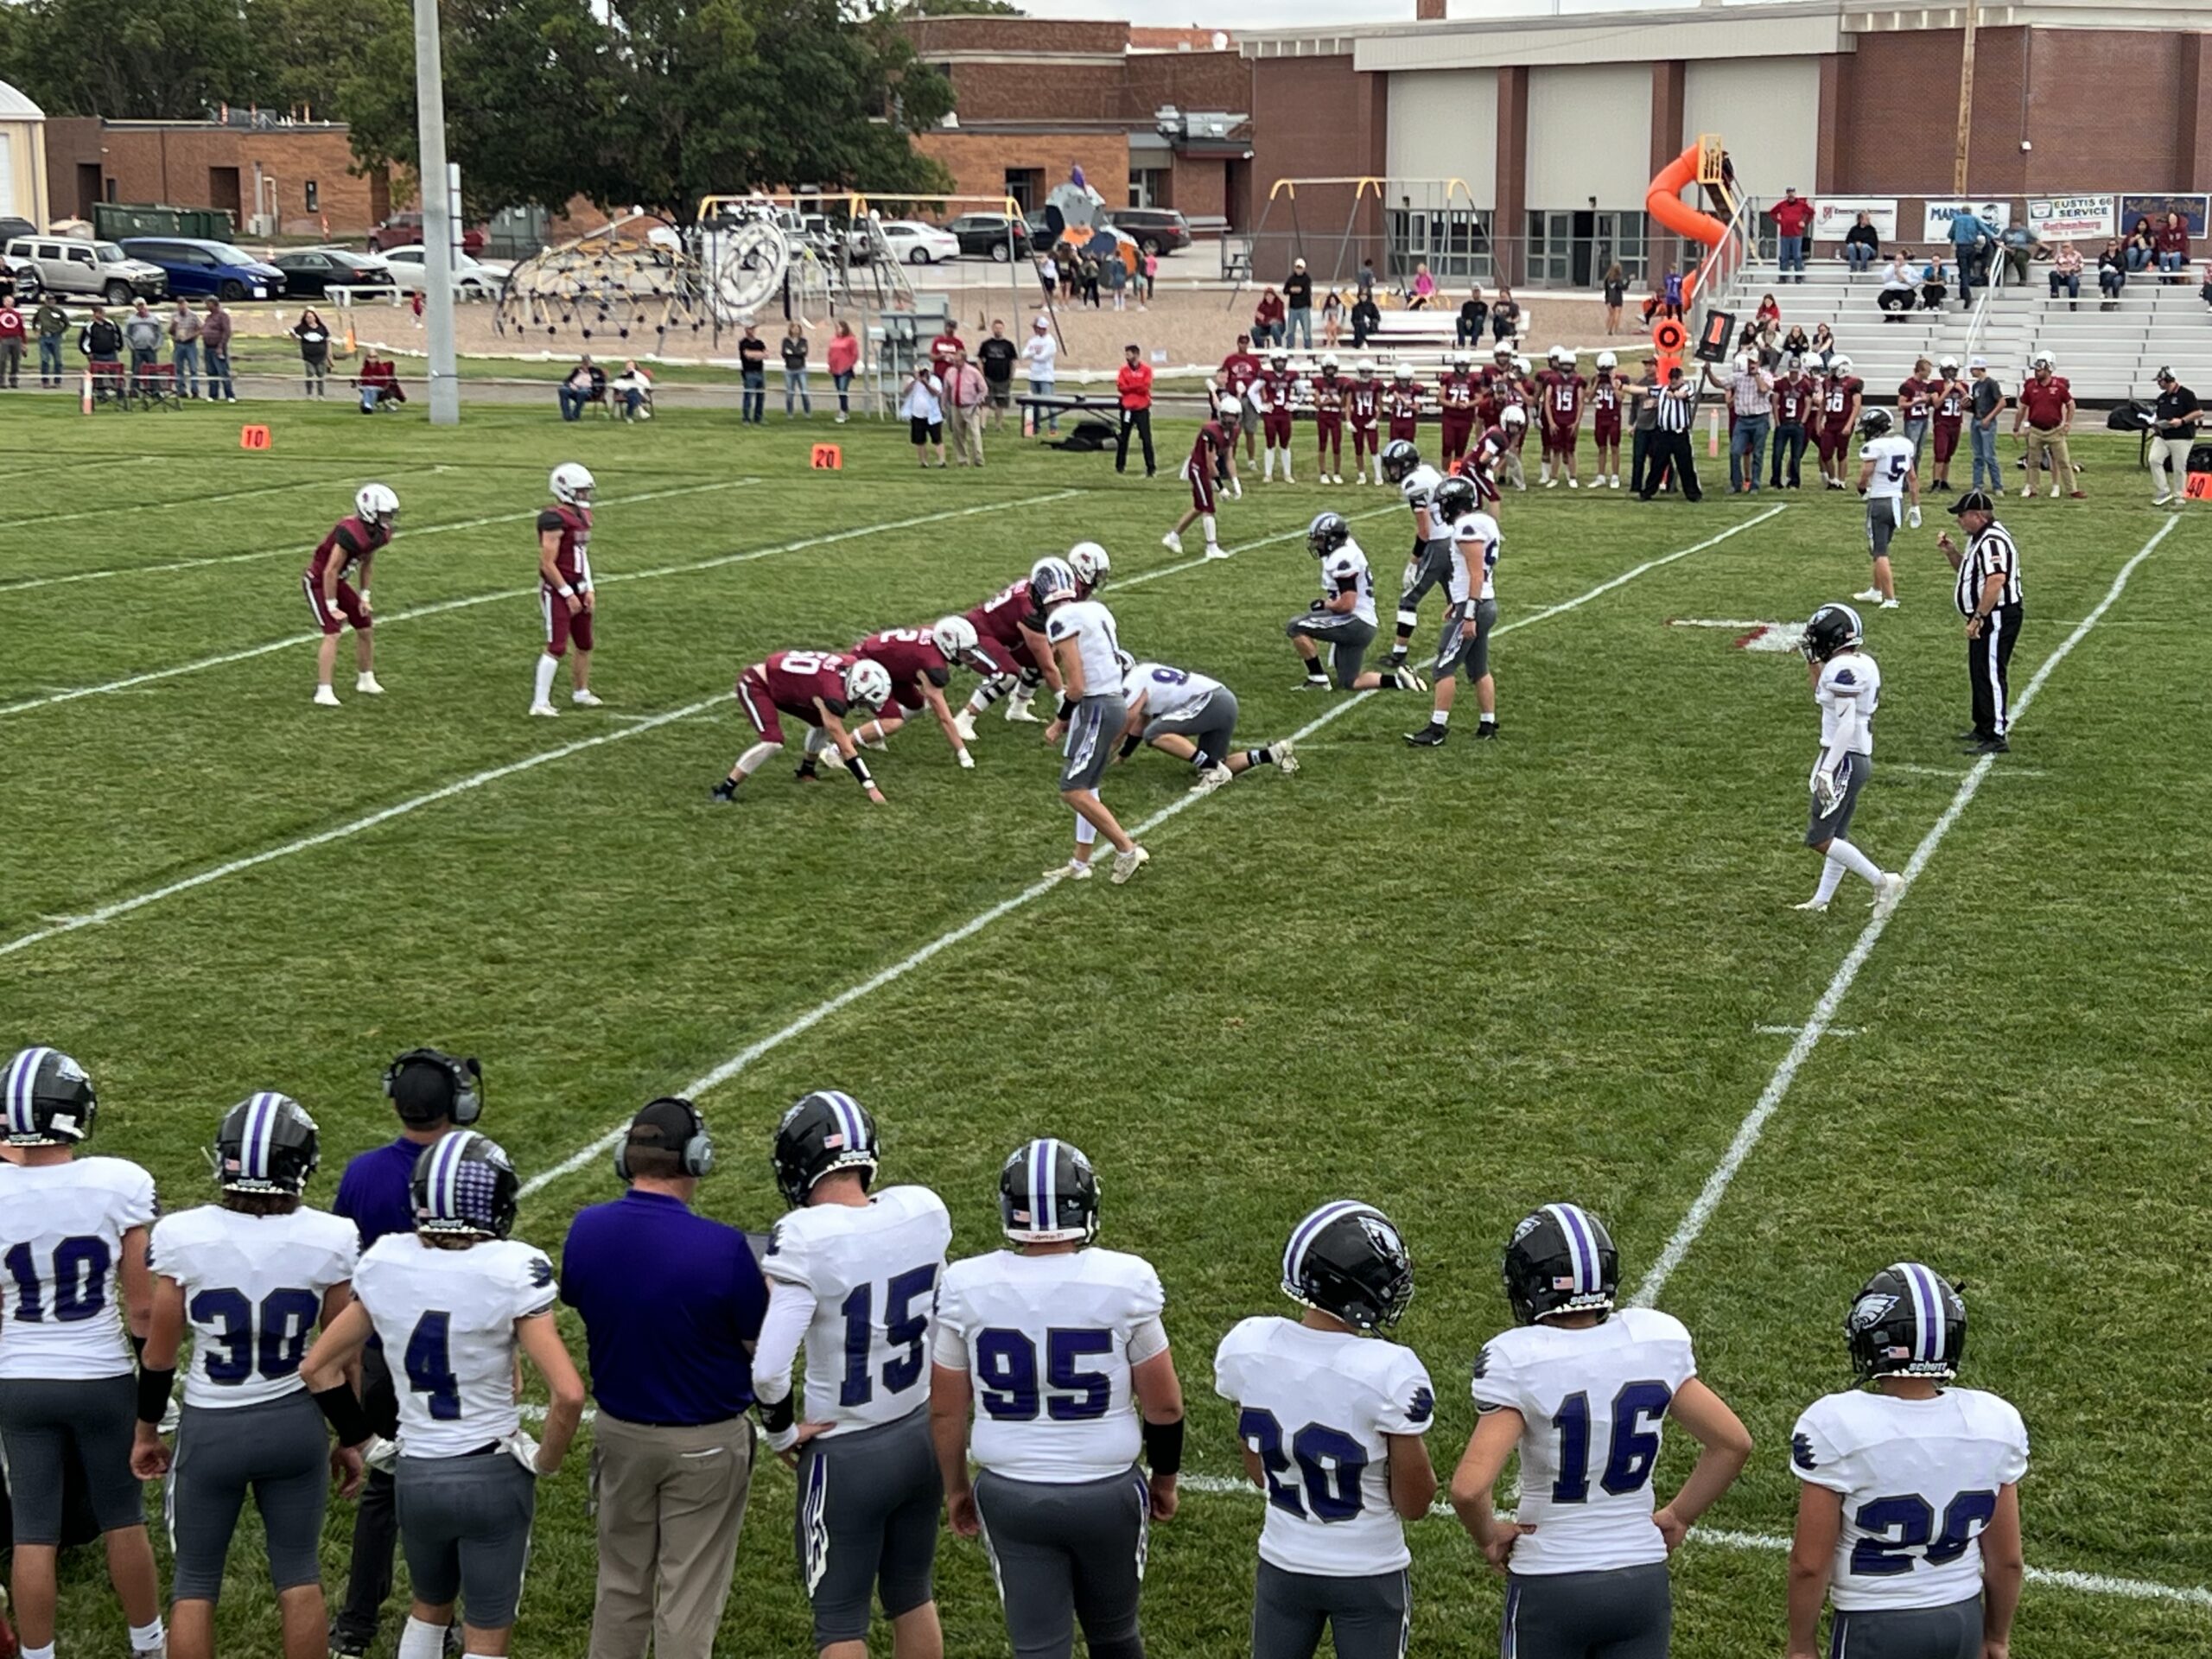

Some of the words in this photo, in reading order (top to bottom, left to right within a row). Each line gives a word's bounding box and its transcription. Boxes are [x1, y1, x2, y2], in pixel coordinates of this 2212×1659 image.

[2054, 199, 2095, 208] EUSTIS
[2100, 197, 2113, 206] 66
[2059, 207, 2107, 217] SERVICE
[1785, 398, 1797, 417] 9
[247, 429, 264, 447] 10
[816, 448, 835, 467] 20
[1888, 454, 1906, 482] 5
[2187, 477, 2205, 498] 40
[4, 1235, 111, 1323] 10
[189, 1287, 322, 1386] 30
[840, 1262, 939, 1408] 15
[404, 1309, 461, 1421] 4
[976, 1327, 1113, 1421] 95
[1238, 1407, 1369, 1523] 20
[1552, 1379, 1674, 1504] 16
